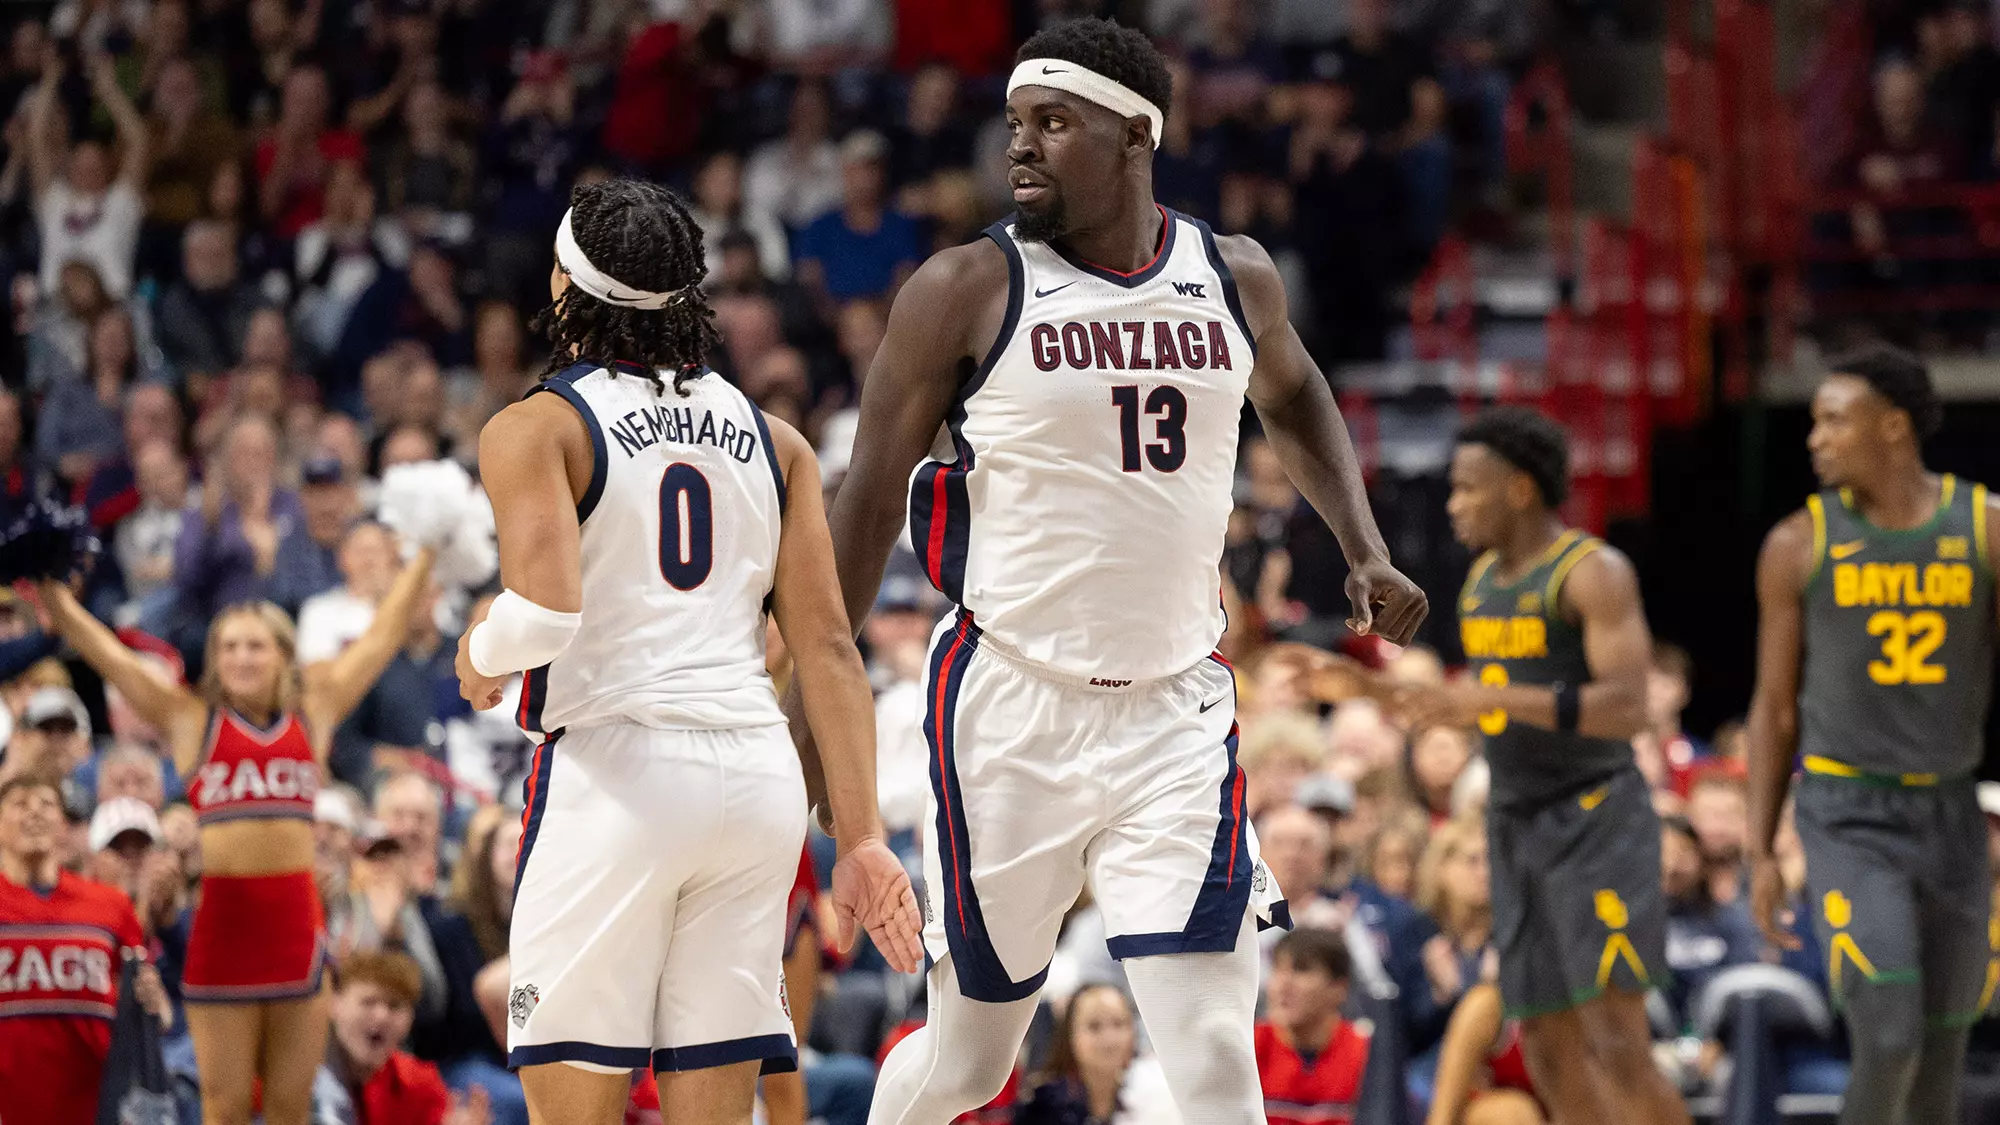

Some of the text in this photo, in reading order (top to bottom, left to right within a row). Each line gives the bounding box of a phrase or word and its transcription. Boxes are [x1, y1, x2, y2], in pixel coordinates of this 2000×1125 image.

[1030, 321, 1233, 372] GONZAGA
[608, 405, 756, 464] NEMBHARD
[1111, 385, 1188, 473] 13
[659, 462, 713, 591] 0
[1834, 562, 1973, 607] BAYLOR
[1866, 610, 1947, 685] 32
[199, 757, 322, 806] ZAGS
